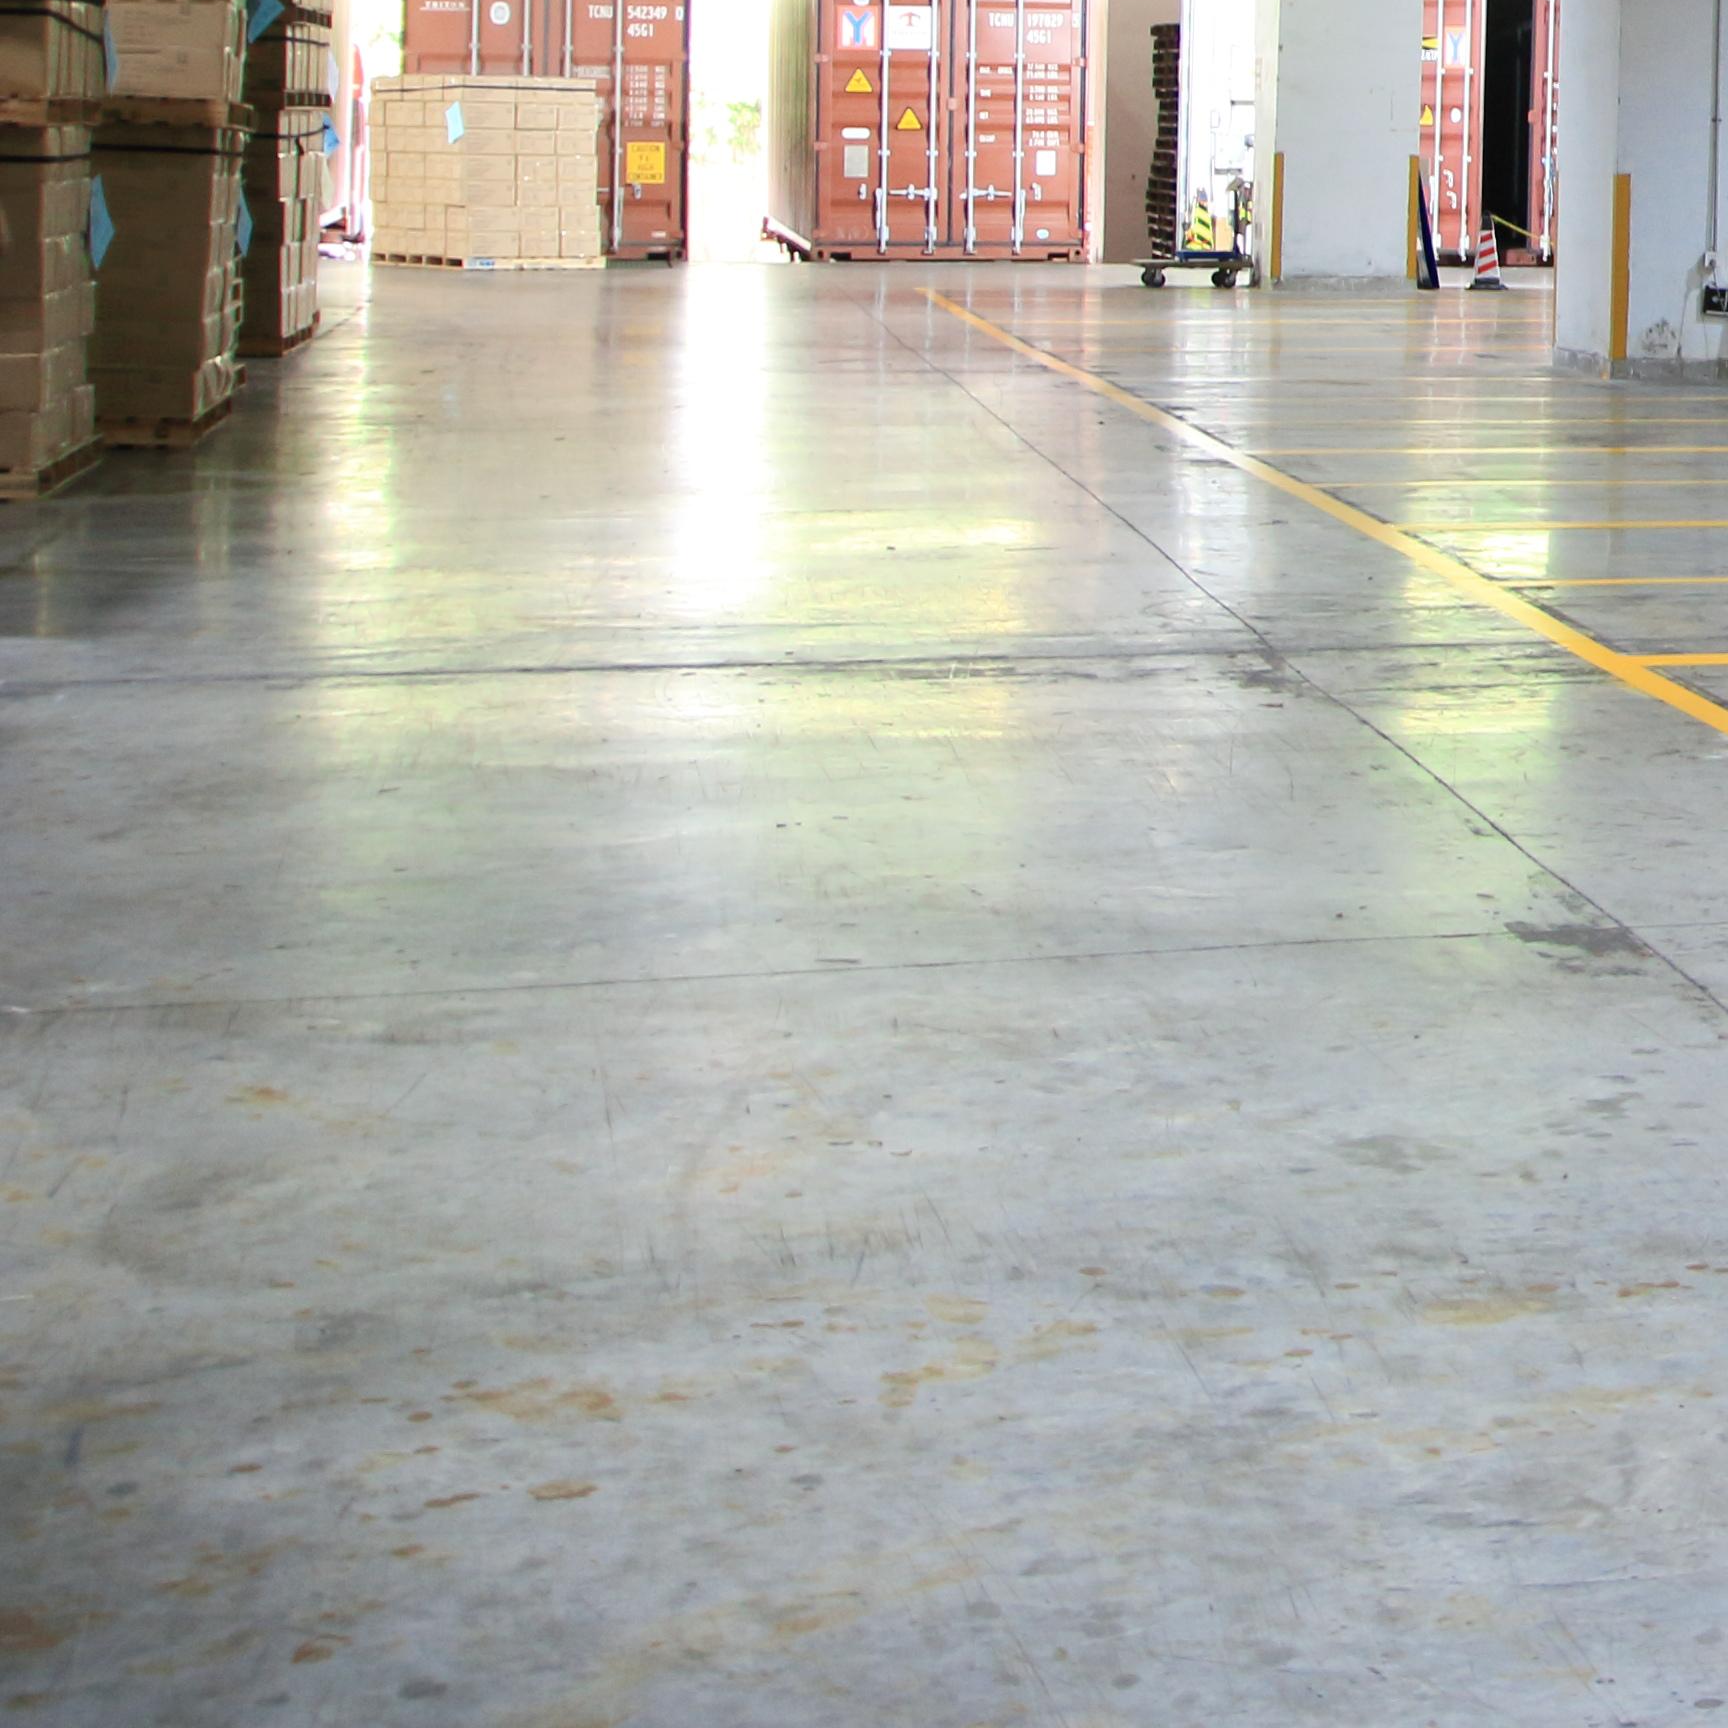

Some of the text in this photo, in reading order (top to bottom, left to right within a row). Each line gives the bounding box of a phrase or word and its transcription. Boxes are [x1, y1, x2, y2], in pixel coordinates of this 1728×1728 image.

[588, 5, 613, 19] TCNU
[627, 6, 668, 19] 542349
[988, 12, 1014, 27] TCNU
[627, 24, 654, 37] 45G1
[1026, 29, 1051, 44] 45G1
